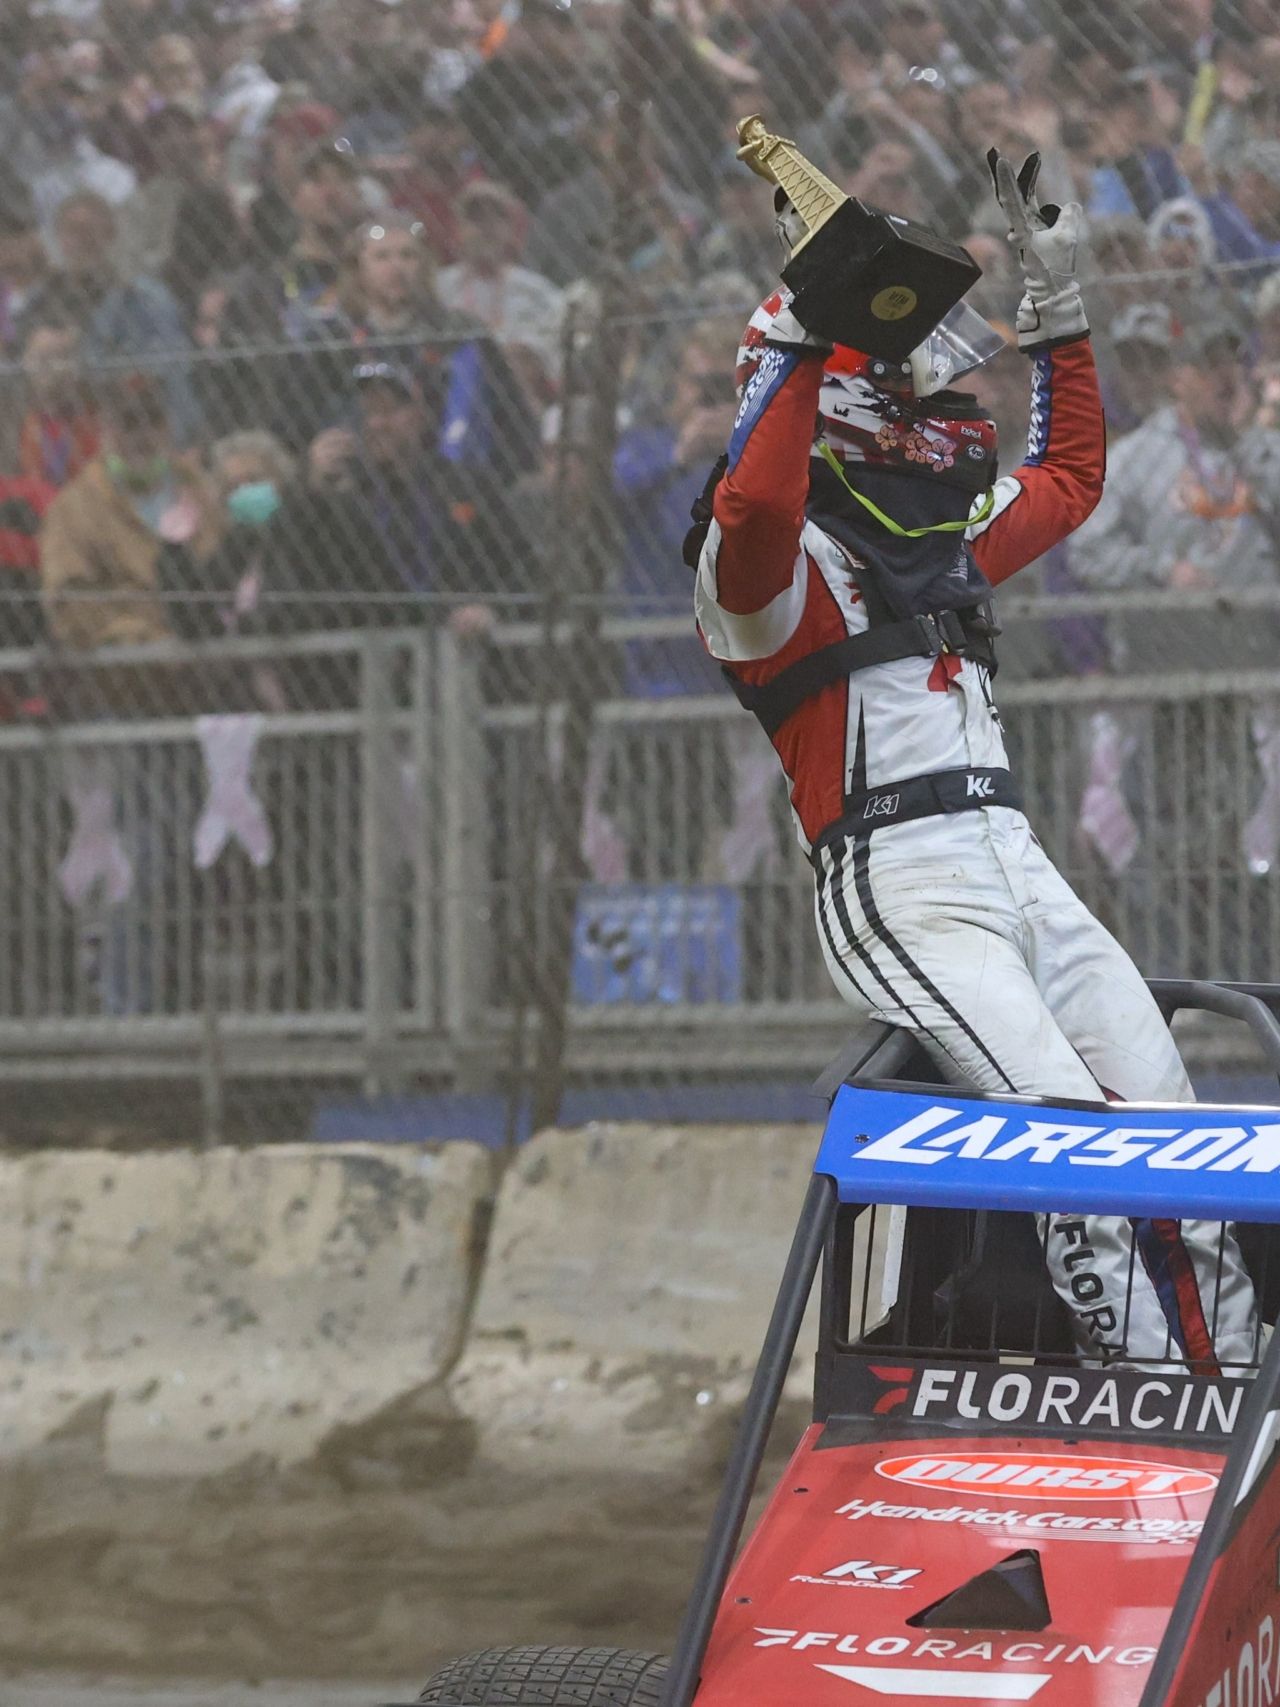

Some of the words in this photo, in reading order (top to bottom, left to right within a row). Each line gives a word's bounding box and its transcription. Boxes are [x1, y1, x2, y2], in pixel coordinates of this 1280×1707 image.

[864, 794, 899, 819] K1
[912, 1369, 1244, 1433] FLORACIN
[898, 1459, 1187, 1492] DURST
[821, 1560, 924, 1584] K1
[792, 1632, 1158, 1665] FLORACING
